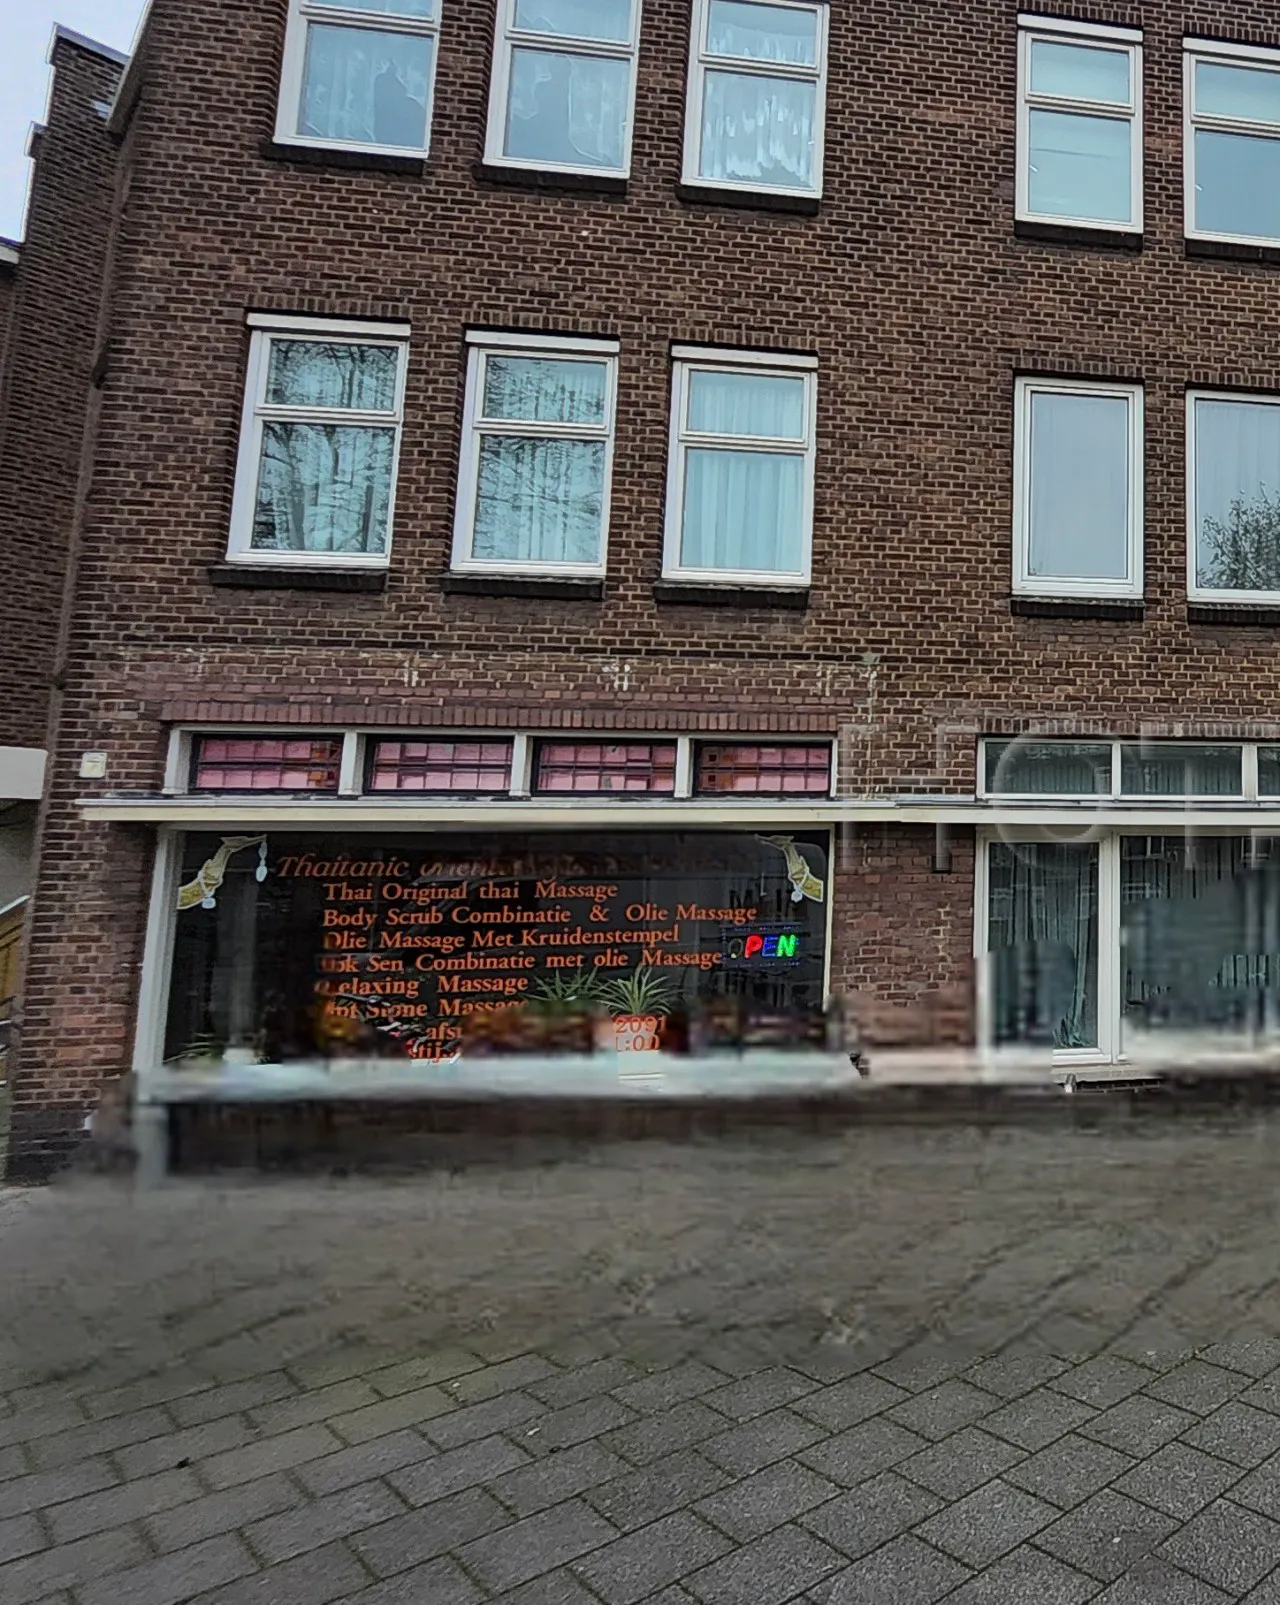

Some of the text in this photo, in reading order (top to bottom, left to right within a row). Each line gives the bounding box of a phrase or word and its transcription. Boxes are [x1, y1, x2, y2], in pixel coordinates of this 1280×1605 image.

[277, 853, 410, 878] Thaitanic
[325, 880, 618, 906] Thai Original thai Massage
[323, 907, 377, 931] Body
[385, 907, 443, 925] Scrub
[451, 904, 571, 924] Combinatie
[589, 904, 609, 922] &
[625, 903, 668, 922] Olie
[675, 903, 757, 926] Massage
[379, 931, 465, 953] Massage
[470, 930, 514, 948] Met
[521, 923, 679, 948] Kruidenstempel
[727, 934, 796, 959] OPEN
[366, 953, 404, 973] Sen
[415, 950, 536, 972] Combinatie
[545, 953, 585, 969] met
[593, 948, 629, 968] olie
[639, 949, 722, 971] Massage
[315, 974, 529, 999] elaxing Massage
